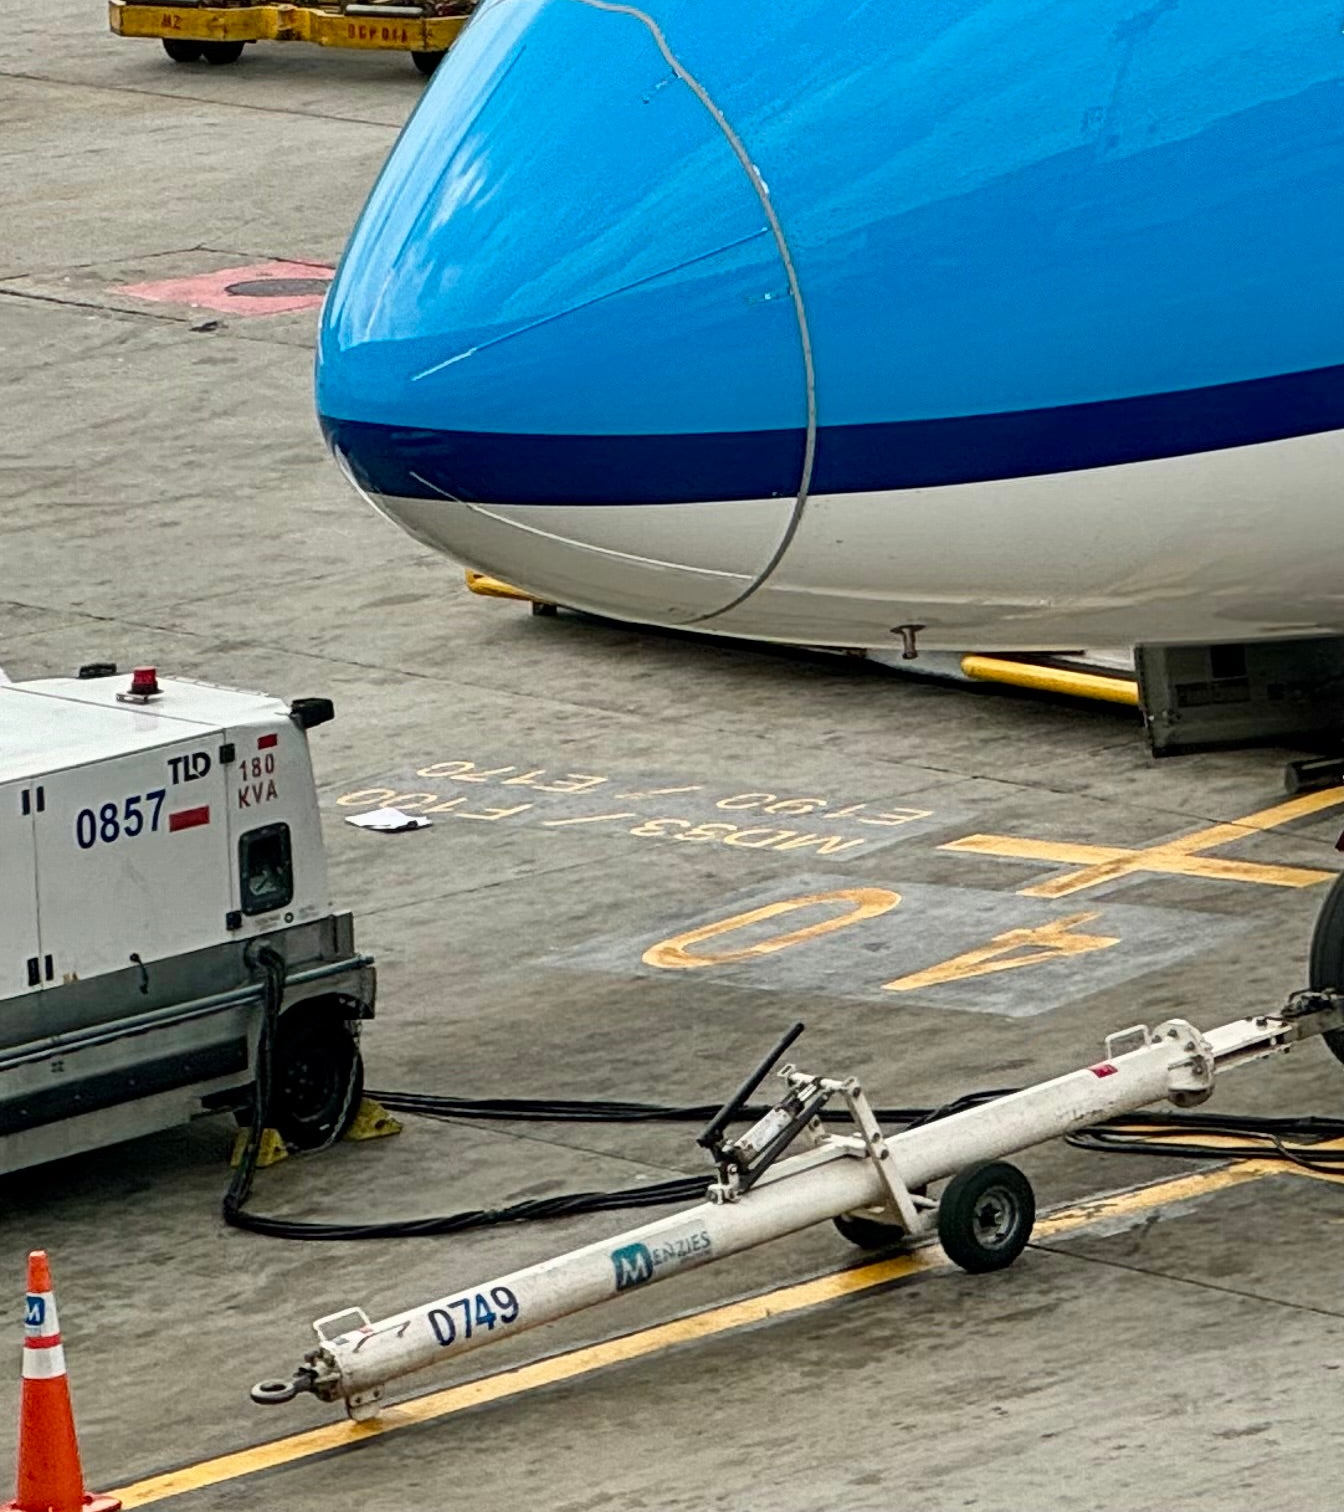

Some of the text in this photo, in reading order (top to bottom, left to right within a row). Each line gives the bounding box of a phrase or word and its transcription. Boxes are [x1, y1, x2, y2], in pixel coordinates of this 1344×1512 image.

[167, 751, 212, 785] TLD
[239, 753, 275, 782] 180
[416, 760, 609, 794] E170
[238, 781, 279, 809] KVA
[715, 791, 935, 828] E190
[76, 788, 166, 849] 0857
[427, 1286, 520, 1347] 0749
